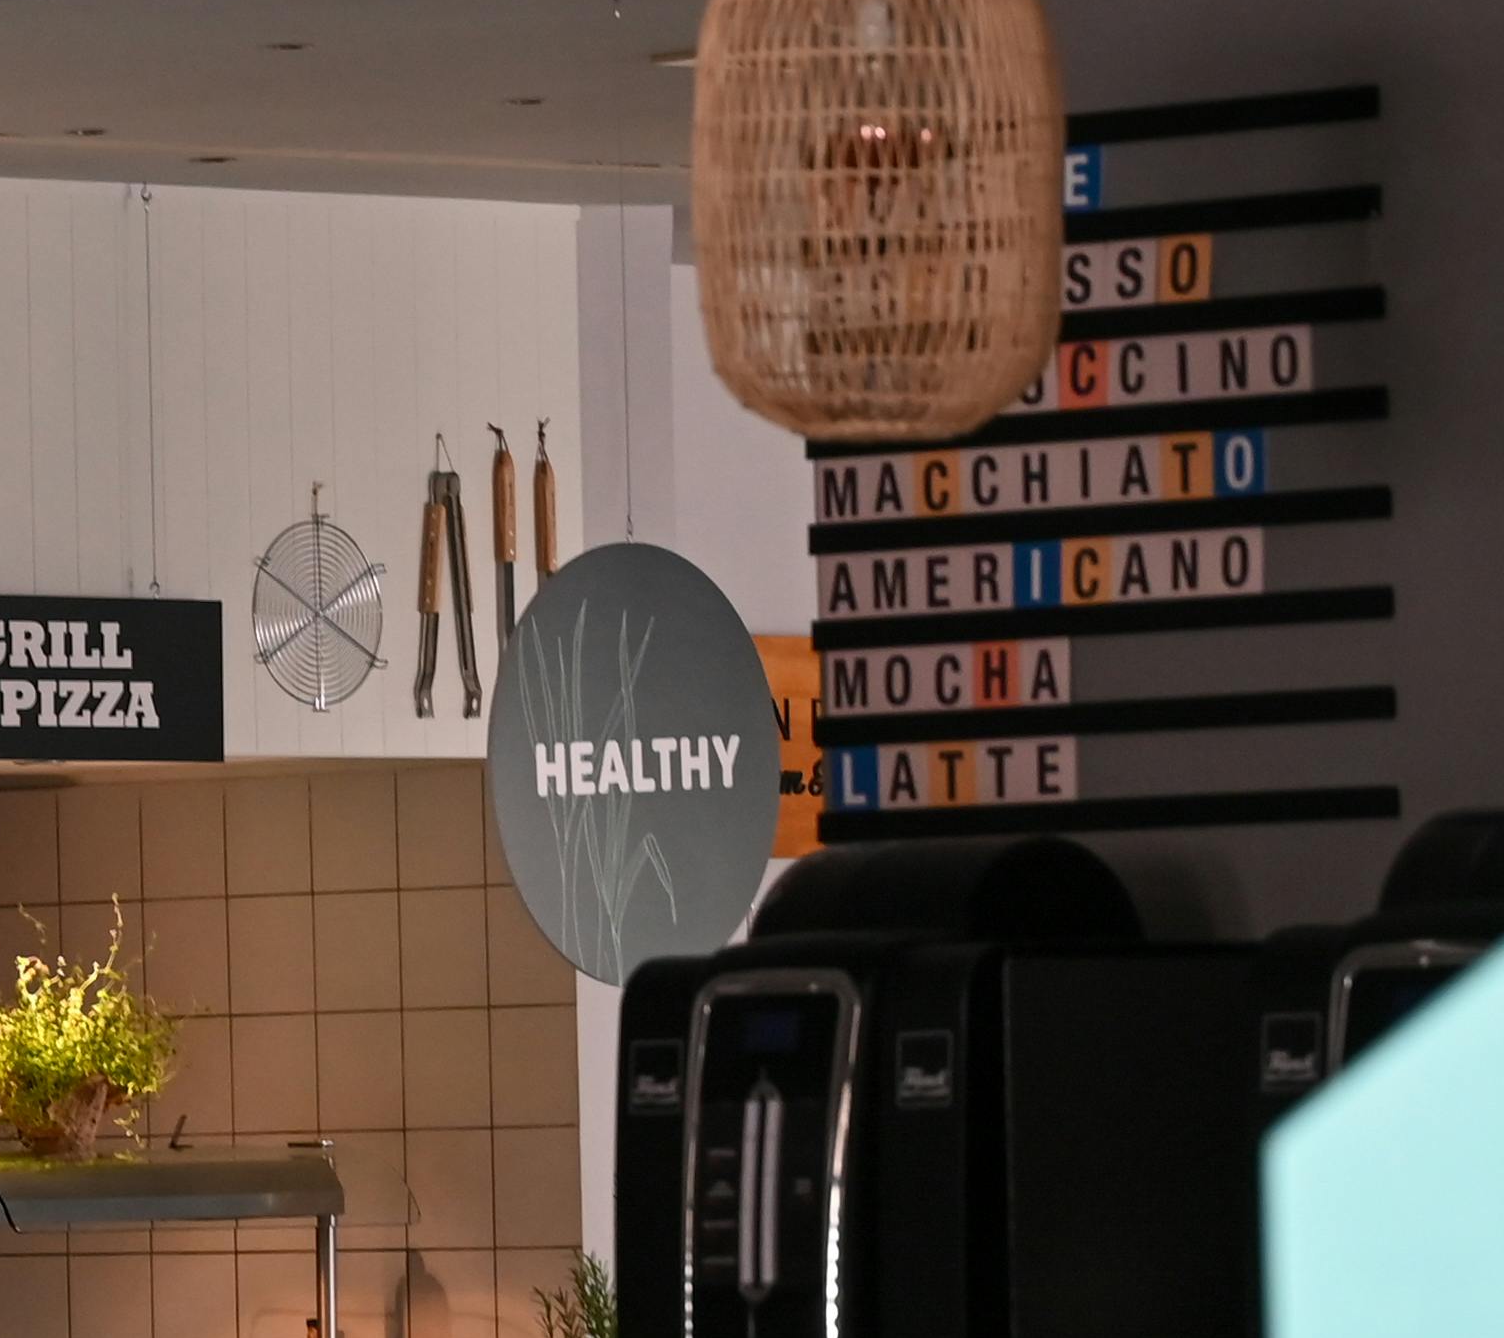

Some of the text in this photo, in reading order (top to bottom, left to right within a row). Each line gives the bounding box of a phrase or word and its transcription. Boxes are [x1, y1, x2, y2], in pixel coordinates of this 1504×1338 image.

[1018, 334, 1300, 406] CCINO
[823, 434, 1256, 519] MACCHIATO
[829, 535, 1250, 613] AMERICANO
[0, 679, 161, 729] PIZZA
[832, 649, 1059, 709] MOCHA
[534, 733, 741, 798] HEALTHY
[840, 743, 1062, 807] LATTE
